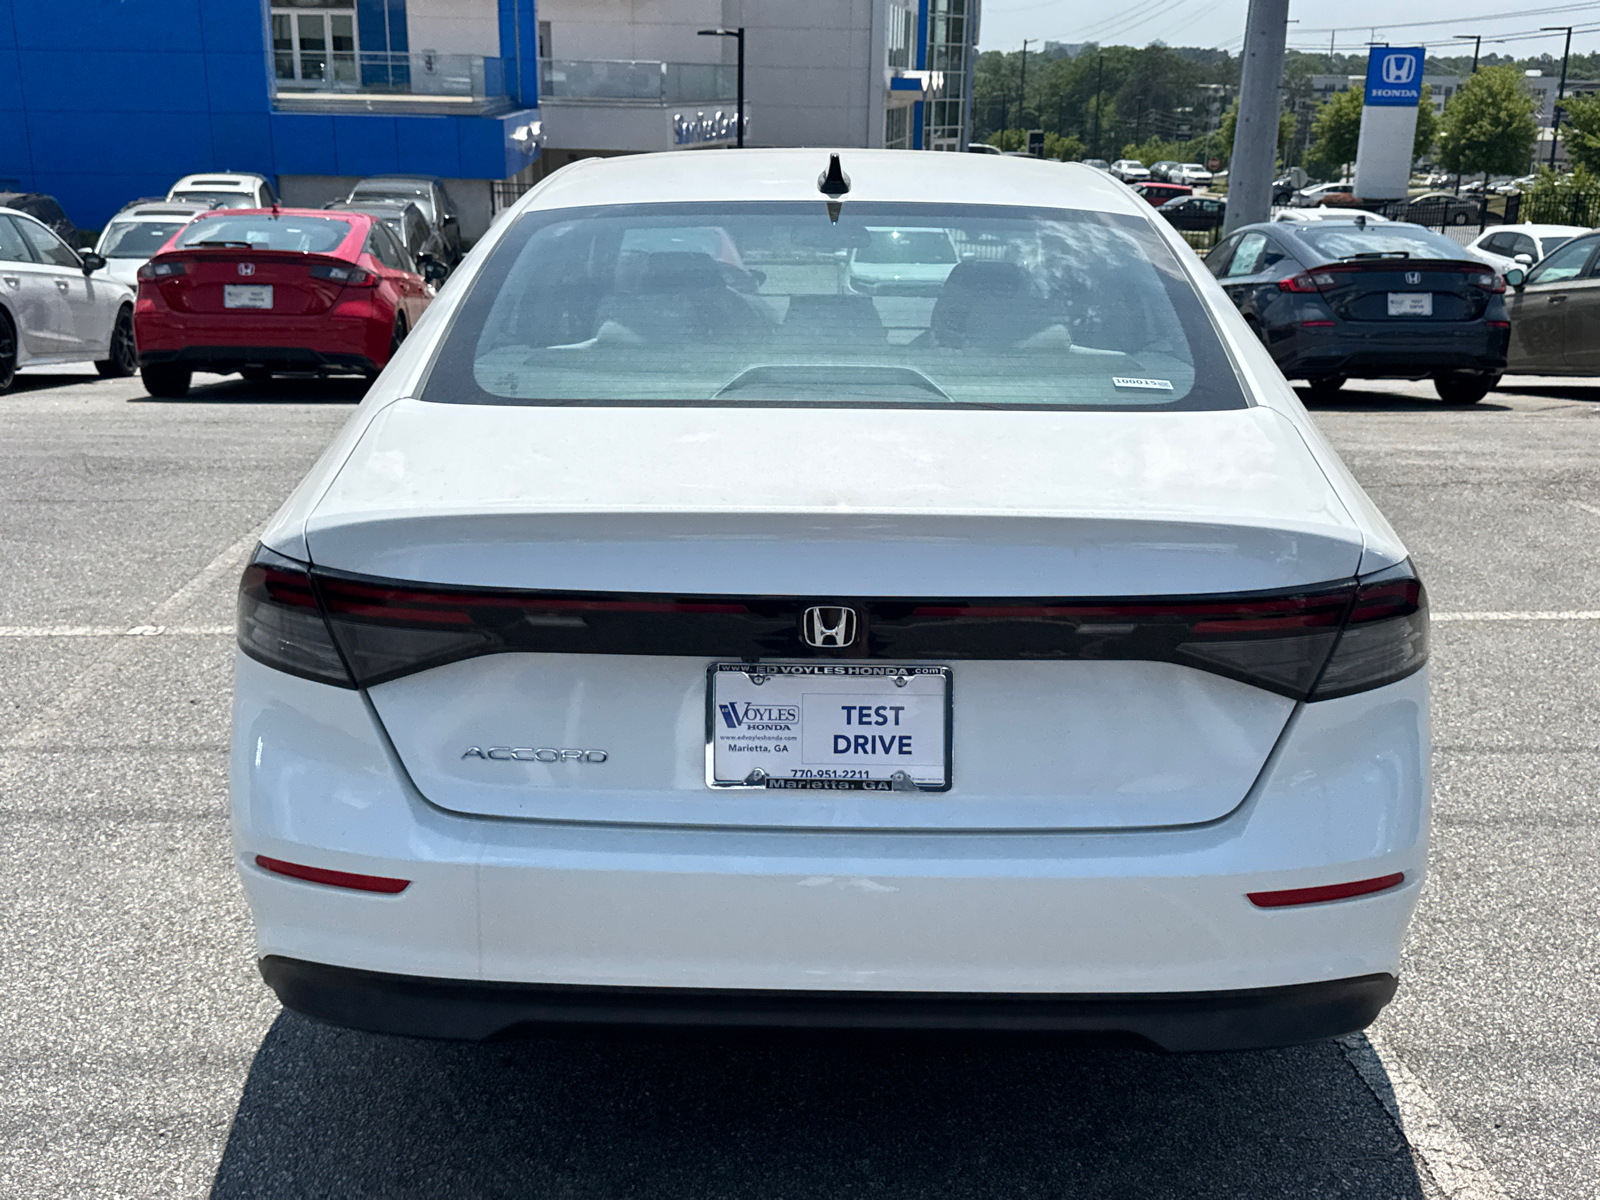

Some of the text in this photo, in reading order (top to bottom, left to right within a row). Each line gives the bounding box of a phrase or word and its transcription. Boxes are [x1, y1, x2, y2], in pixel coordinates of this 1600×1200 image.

[1372, 89, 1418, 97] HONDA
[1116, 378, 1158, 386] 100015
[728, 702, 796, 726] VOYLES
[841, 706, 905, 726] TEST
[720, 734, 797, 742] www.edvoyleshonda.com
[728, 744, 789, 753] Marietta, GA
[833, 734, 913, 755] DRIVE
[461, 745, 609, 763] ACCORD
[790, 769, 869, 779] 770-951-2211
[769, 779, 890, 790] Marietta, GA
